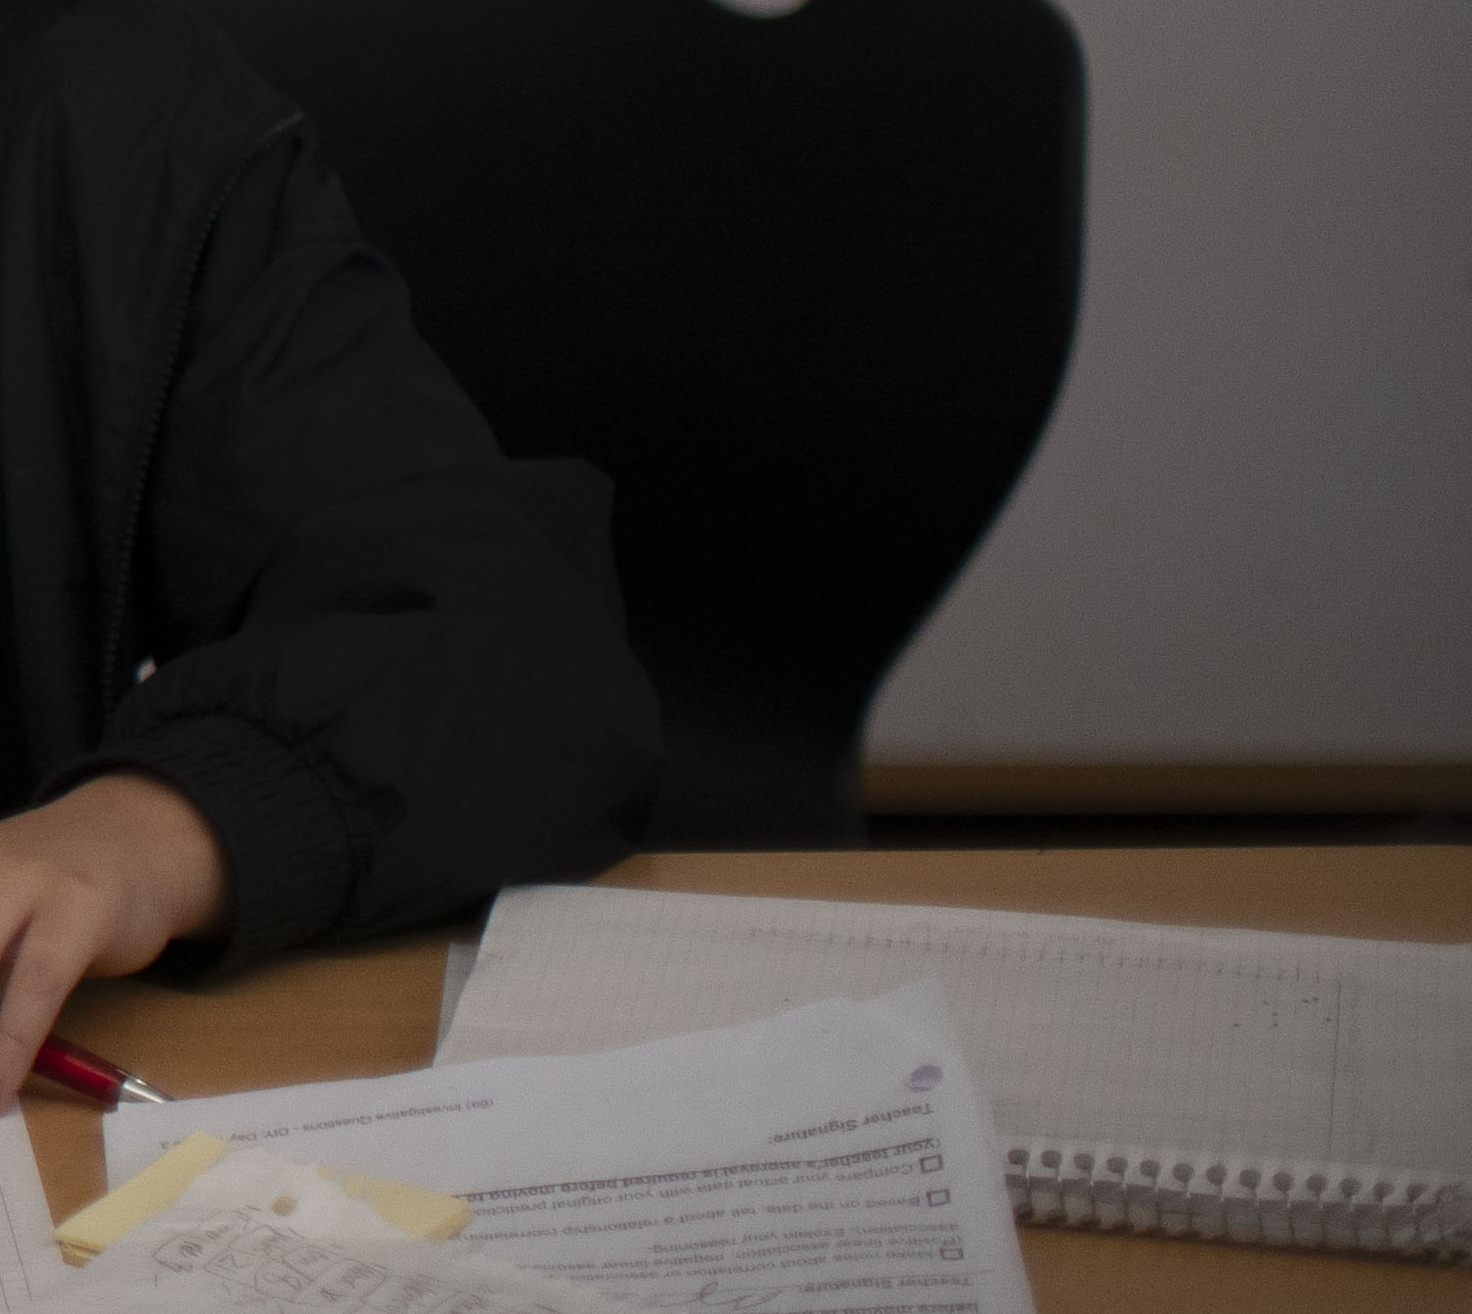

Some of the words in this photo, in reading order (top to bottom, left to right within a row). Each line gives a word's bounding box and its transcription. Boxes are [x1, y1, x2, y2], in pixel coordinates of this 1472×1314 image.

[375, 1103, 461, 1121] Investigative
[861, 1103, 933, 1126] Teacher
[303, 1115, 372, 1132] Questions
[230, 1132, 258, 1143] Day
[767, 1119, 858, 1145] Signature:
[893, 1137, 941, 1157] (your
[805, 1149, 889, 1170] teacher's
[701, 1169, 718, 1179] is
[722, 1161, 801, 1178] approval
[835, 1164, 914, 1182] Compare
[622, 1171, 697, 1189] required
[738, 1177, 790, 1190] actual
[792, 1172, 832, 1184] your
[489, 1185, 556, 1201] moving
[560, 1180, 617, 1193] before
[658, 1186, 693, 1199] with
[696, 1181, 733, 1194] data
[615, 1186, 654, 1203] your
[472, 1200, 547, 1217] predictio
[551, 1196, 613, 1212] original
[808, 1201, 834, 1211] the
[839, 1200, 861, 1210] on
[865, 1196, 921, 1209] Based
[679, 1209, 726, 1224] about
[561, 1218, 658, 1237] relationship
[741, 1231, 779, 1244] your
[652, 1253, 724, 1267] negative
[780, 1255, 827, 1270] about
[897, 1276, 974, 1288] Teacher
